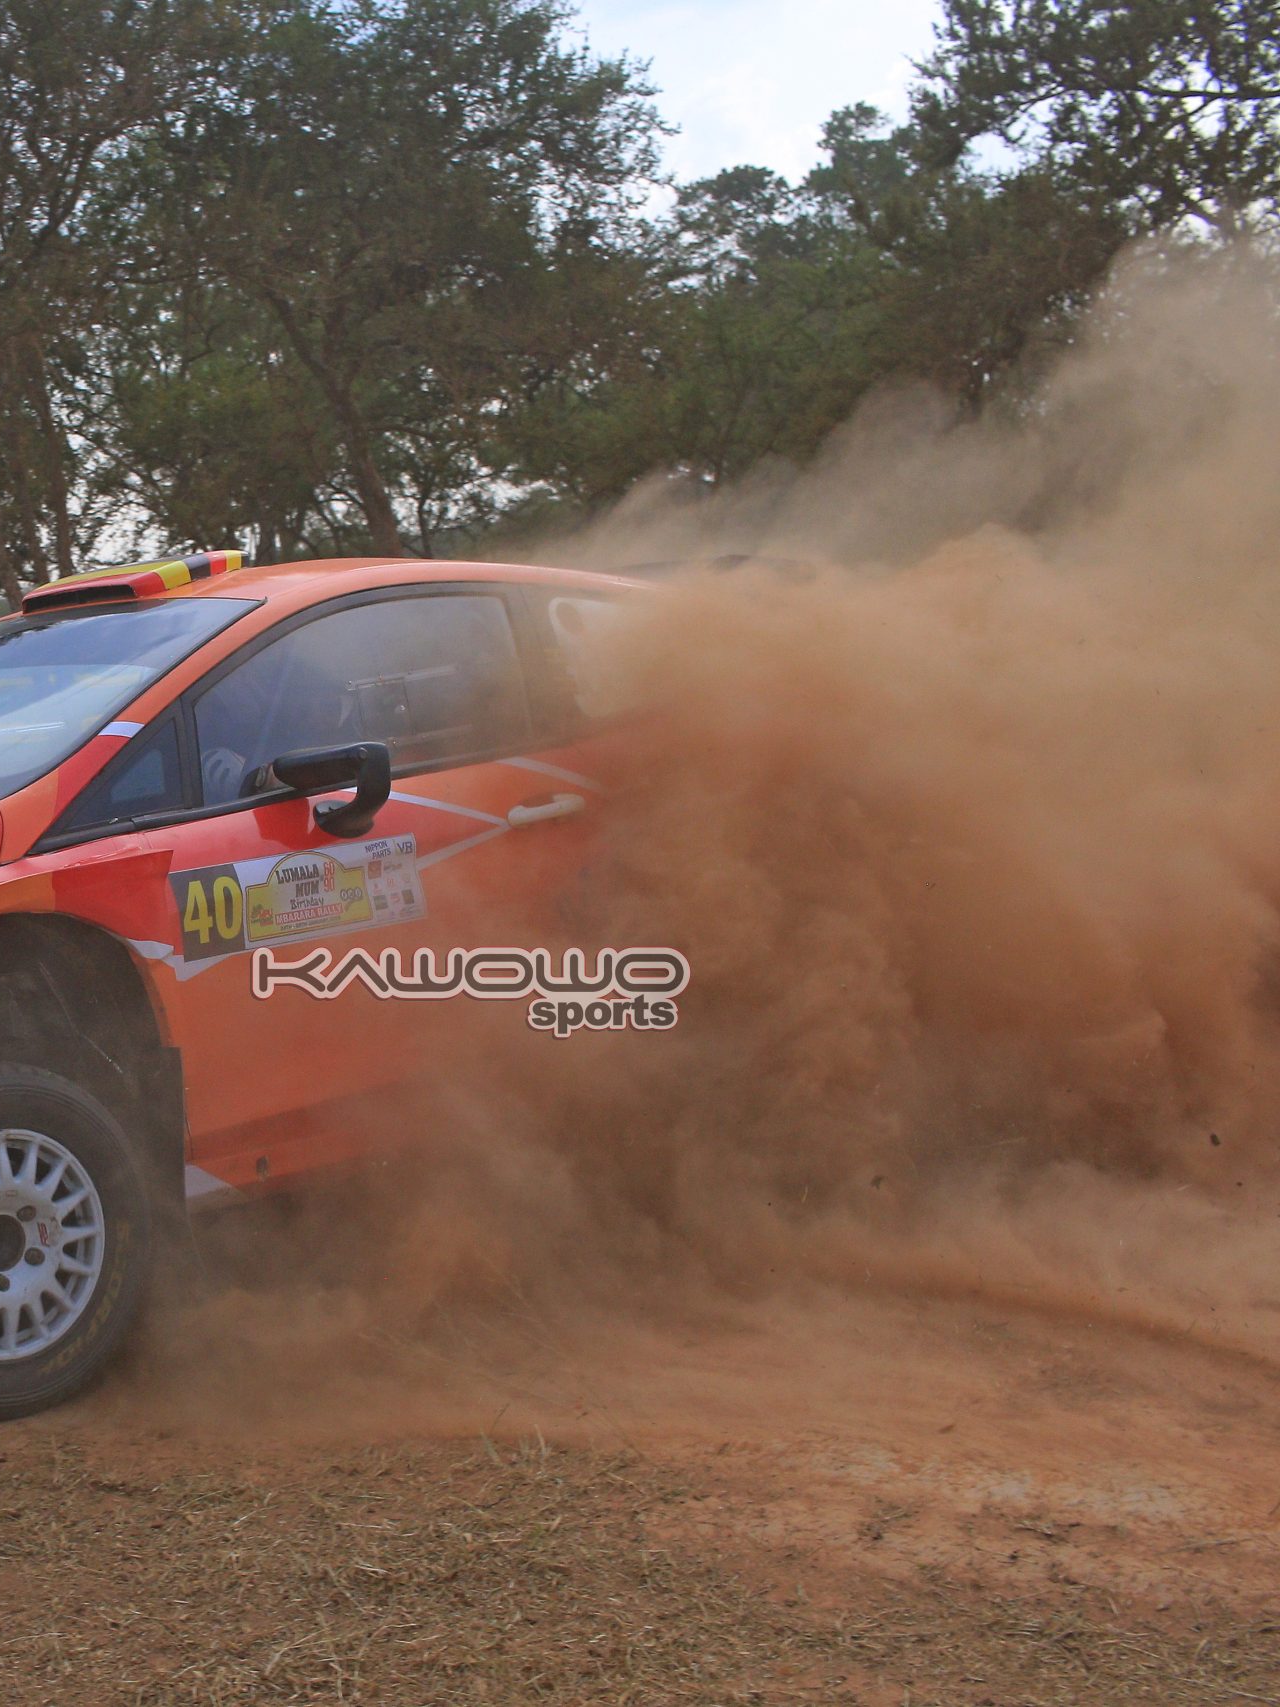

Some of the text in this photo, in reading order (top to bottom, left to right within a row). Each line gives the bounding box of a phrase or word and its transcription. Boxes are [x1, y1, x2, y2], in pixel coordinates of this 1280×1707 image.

[365, 841, 388, 854] NIPPON
[372, 848, 392, 860] PARTS
[276, 864, 320, 885] LUMALA
[295, 881, 320, 898] MUM
[184, 876, 243, 944] 40
[276, 908, 316, 925] MBARARA
[317, 903, 342, 917] RALLY
